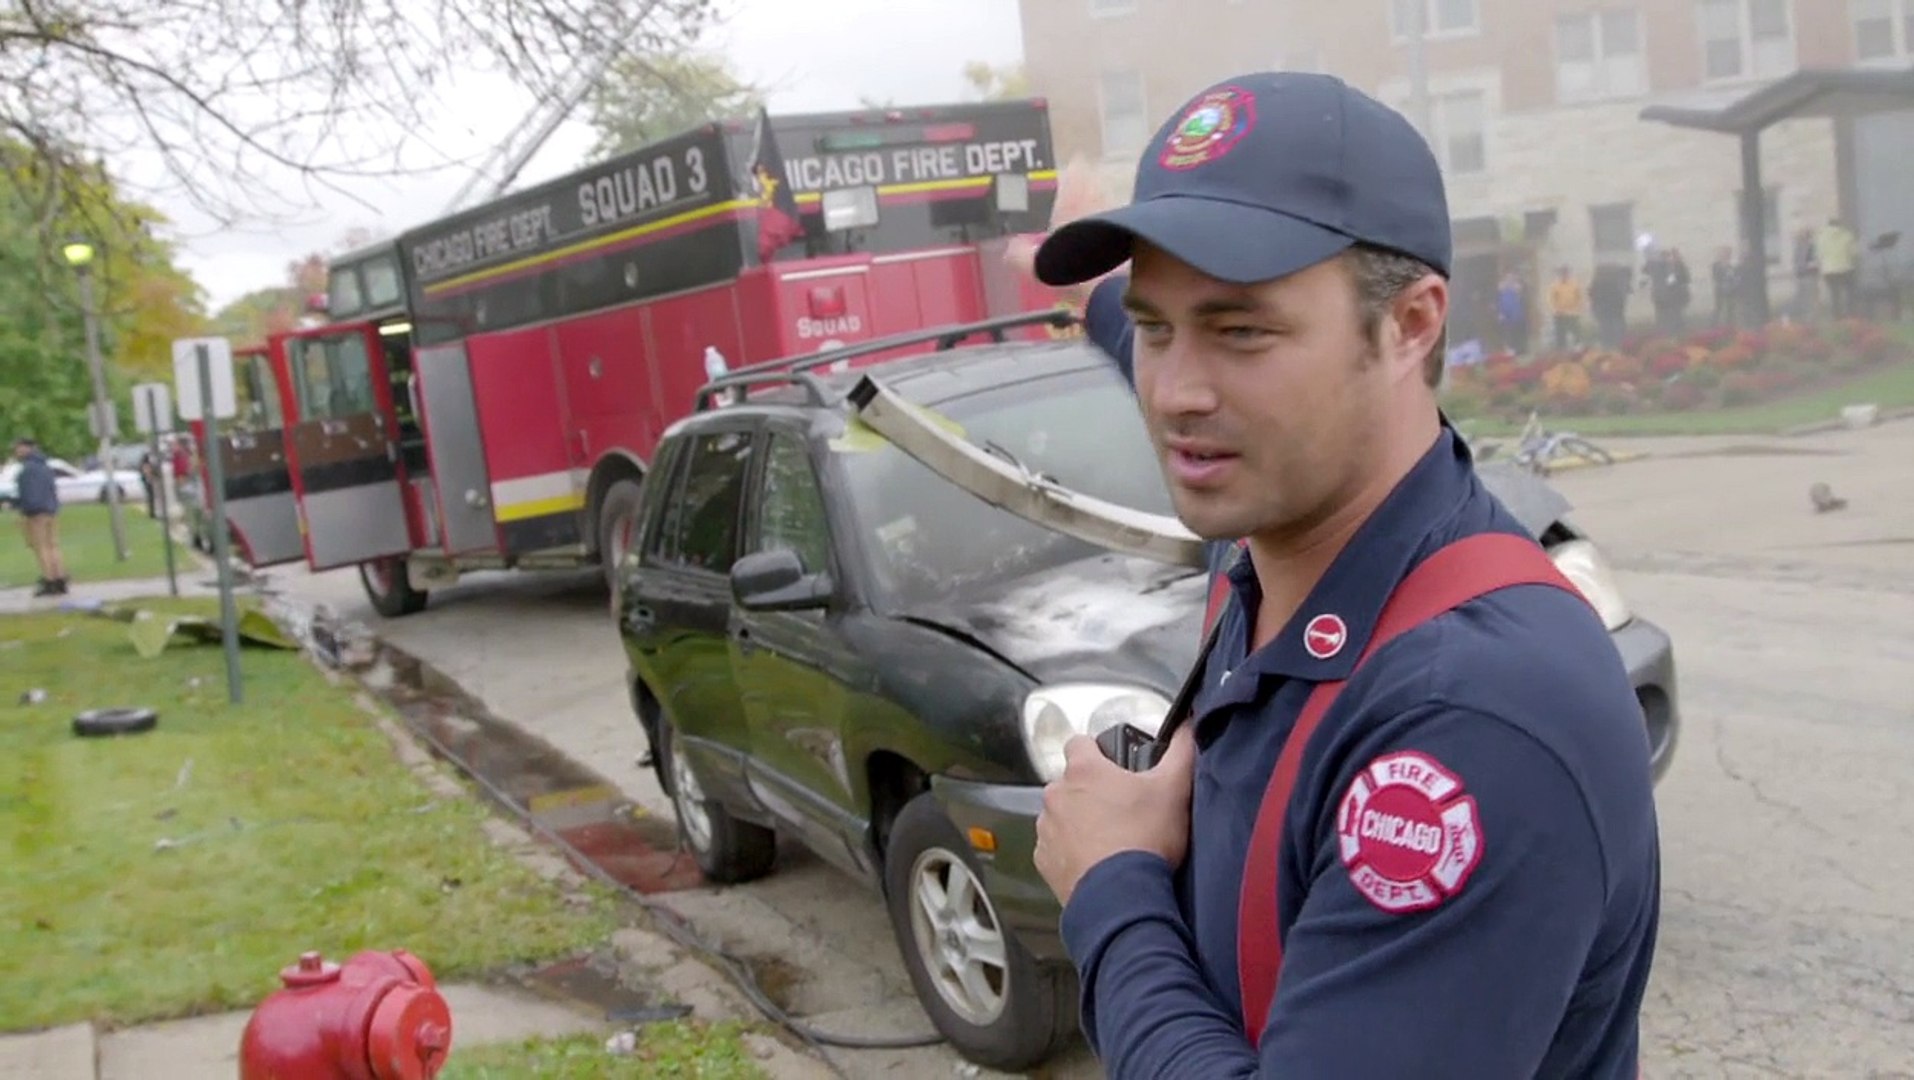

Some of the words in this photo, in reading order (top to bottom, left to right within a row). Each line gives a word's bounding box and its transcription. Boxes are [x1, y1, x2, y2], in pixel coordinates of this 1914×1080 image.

[578, 155, 678, 226] SQUAD
[685, 146, 707, 193] 3
[751, 153, 884, 192] ICAGO
[892, 145, 960, 181] FIRE
[965, 139, 1043, 174] DEPT.
[413, 230, 475, 276] CHICAGO
[473, 217, 510, 259] FIRE
[797, 316, 861, 338] SQUAD
[1388, 762, 1440, 789] FIRE
[1361, 809, 1442, 855] CHICAGO
